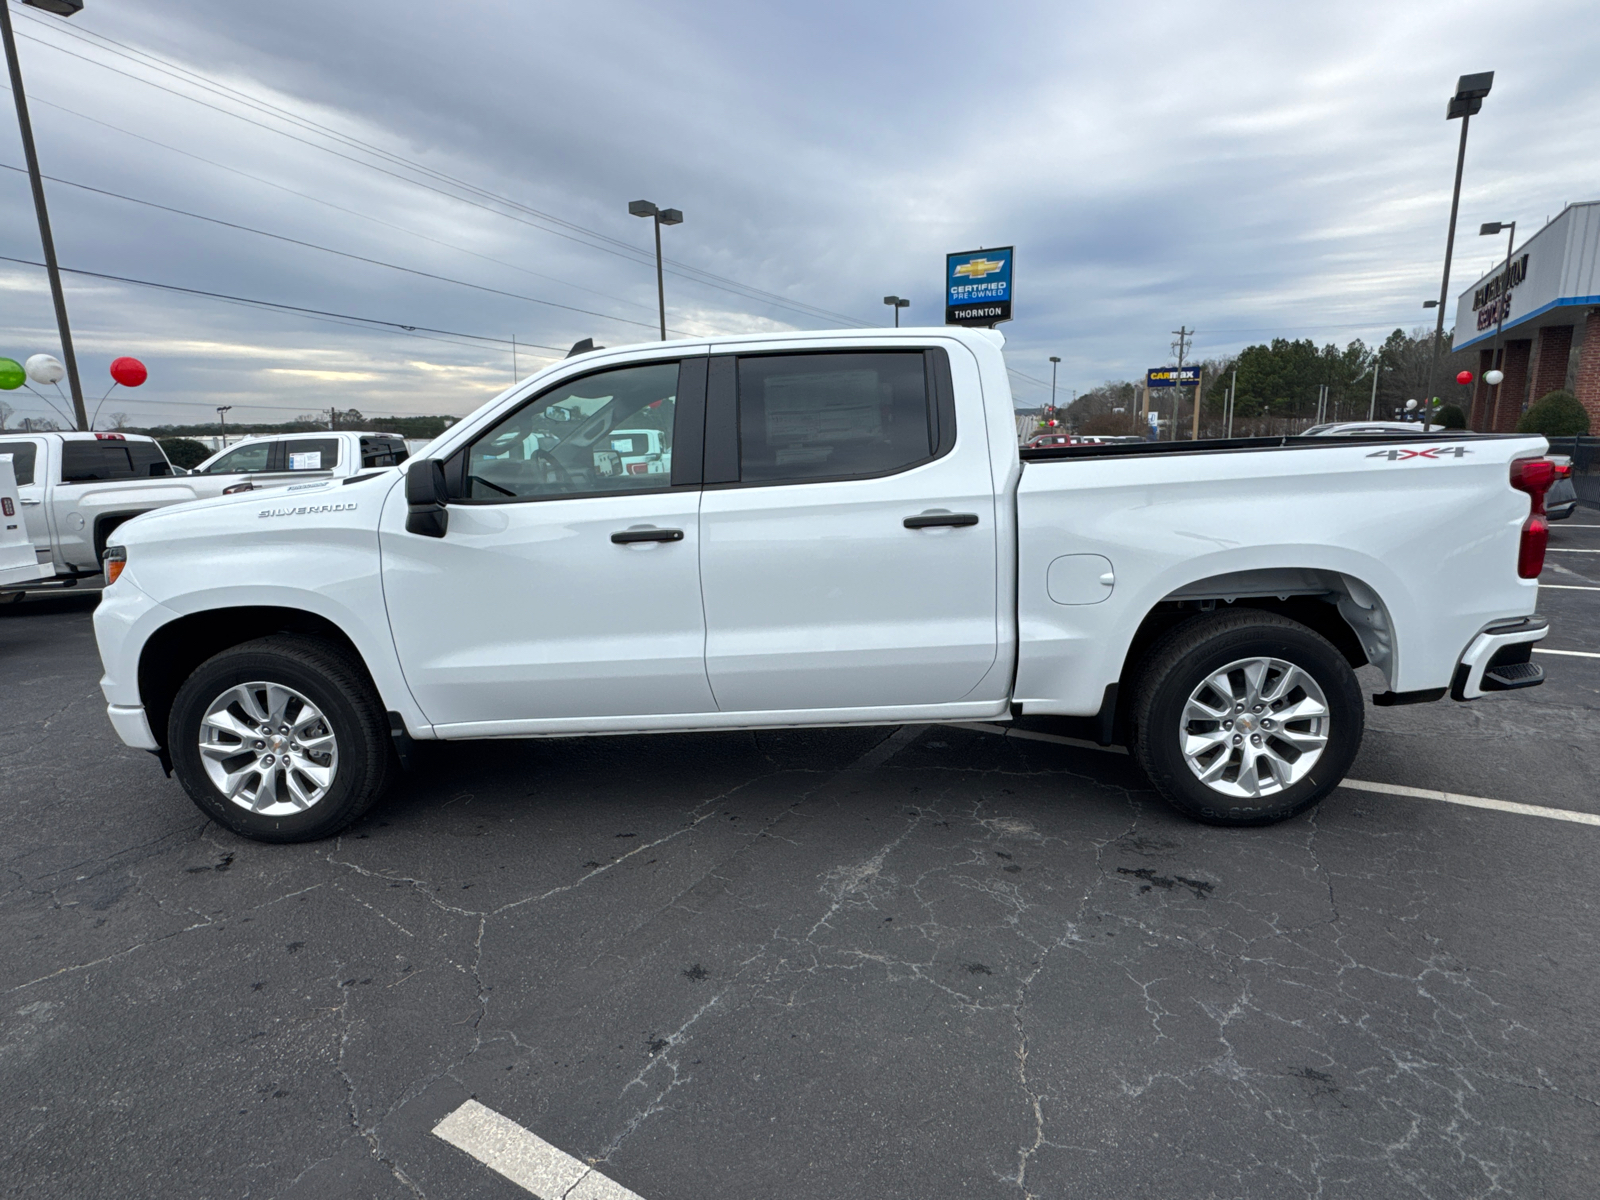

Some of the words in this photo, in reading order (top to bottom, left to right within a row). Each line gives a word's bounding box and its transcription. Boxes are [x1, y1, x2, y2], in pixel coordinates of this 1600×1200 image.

[951, 281, 1007, 294] CERTIFIED
[953, 289, 1004, 300] PRE-OWNED
[954, 307, 1002, 319] THORNTON
[258, 502, 358, 518] SILVERADO
